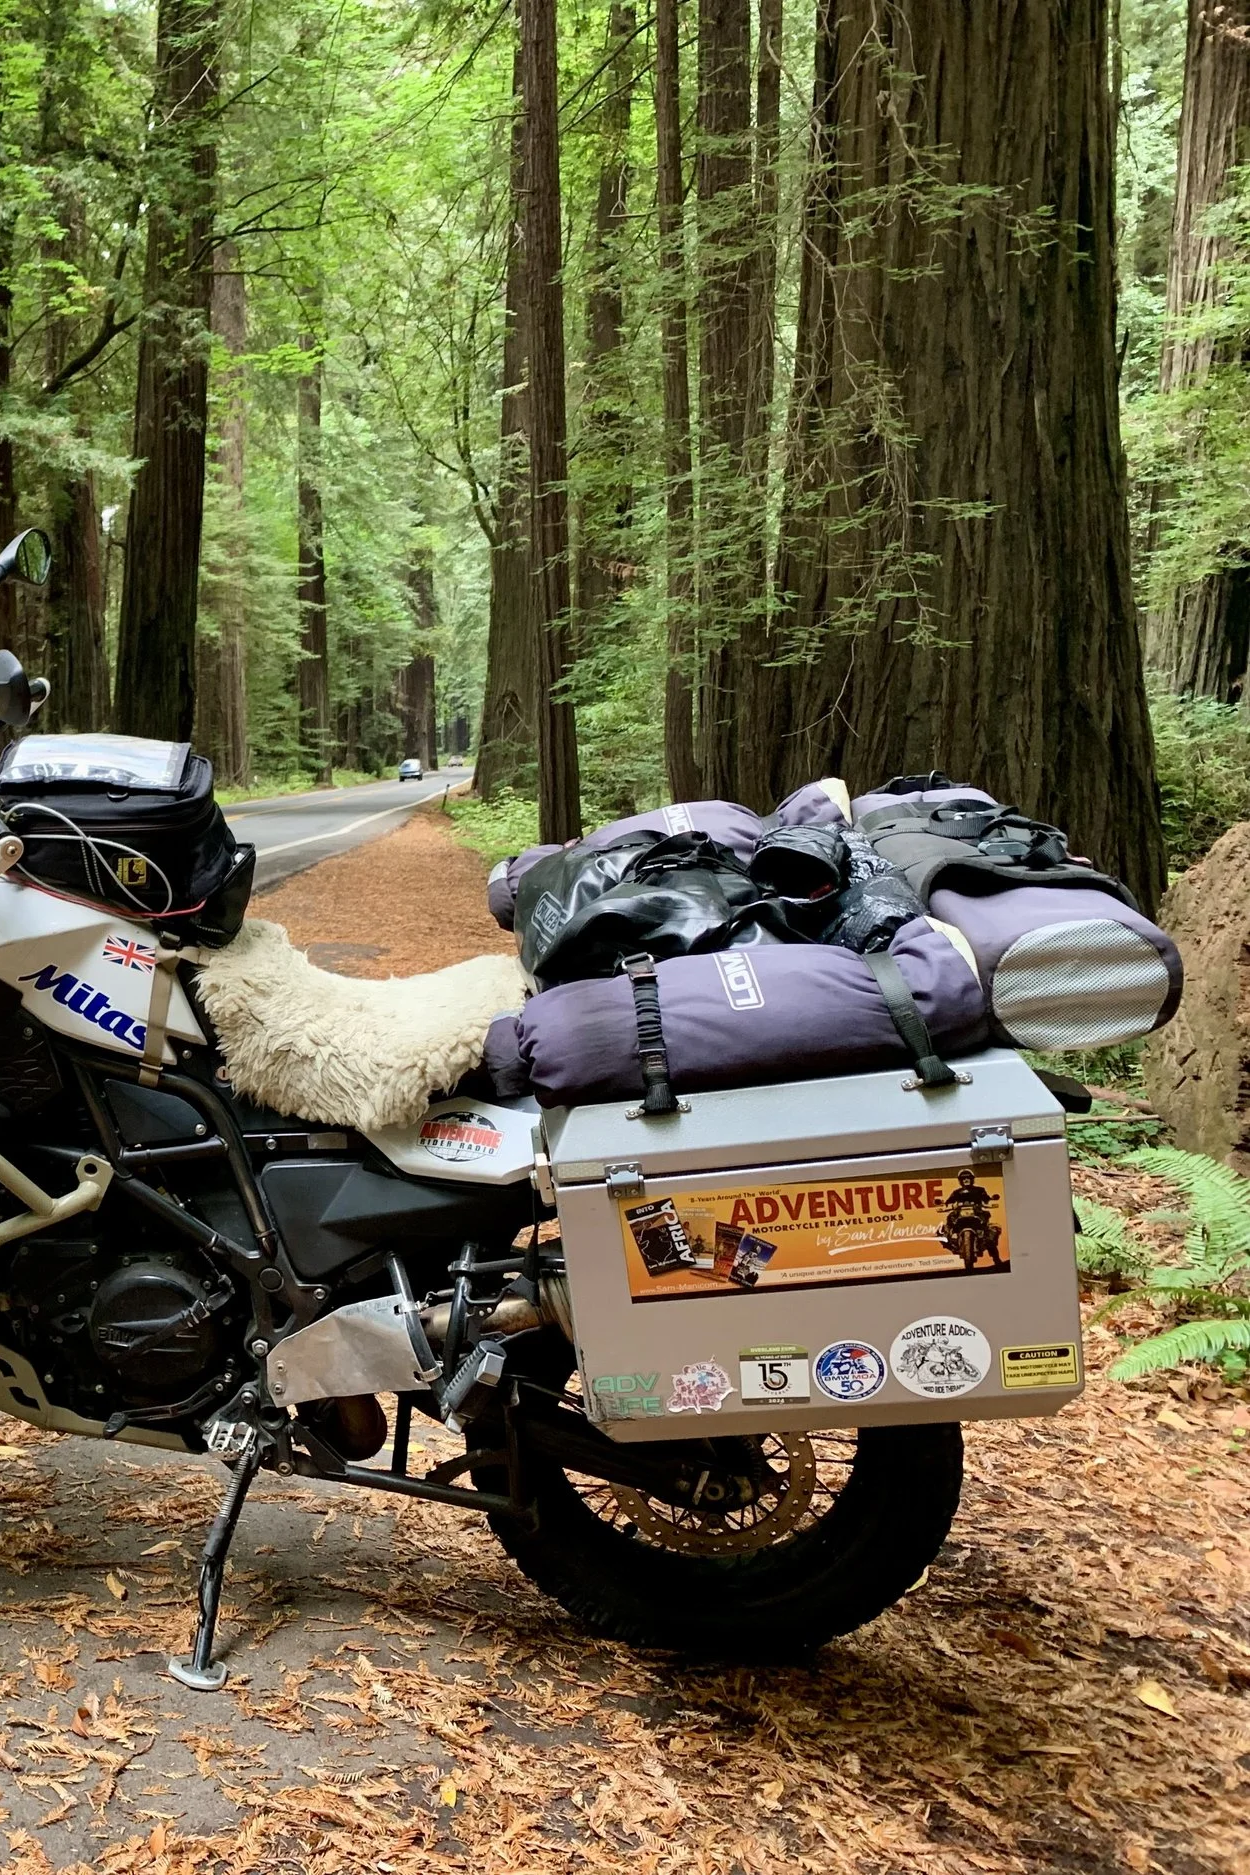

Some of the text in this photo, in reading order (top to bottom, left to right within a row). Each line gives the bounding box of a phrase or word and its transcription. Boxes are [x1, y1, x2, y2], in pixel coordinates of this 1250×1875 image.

[718, 952, 759, 1006] LOM
[17, 964, 147, 1051] Mitas
[419, 1121, 503, 1149] ADVENTURE
[419, 1138, 495, 1155] RIDER RADIO
[636, 1204, 655, 1215] INTO
[729, 1179, 944, 1226] ADVENTURE
[660, 1200, 696, 1263] AFRICA
[752, 1213, 905, 1234] MOTORCYCLE TRAVEL BOOKS
[816, 1218, 945, 1247] by Sam Manicom
[817, 1266, 831, 1276] and
[833, 1263, 872, 1274] wonderful
[901, 1322, 976, 1341] ADVENTURE ADDICT
[1019, 1350, 1058, 1359] CAUTION
[594, 1374, 657, 1393] ADV
[758, 1363, 788, 1391] 15
[841, 1380, 864, 1394] 50
